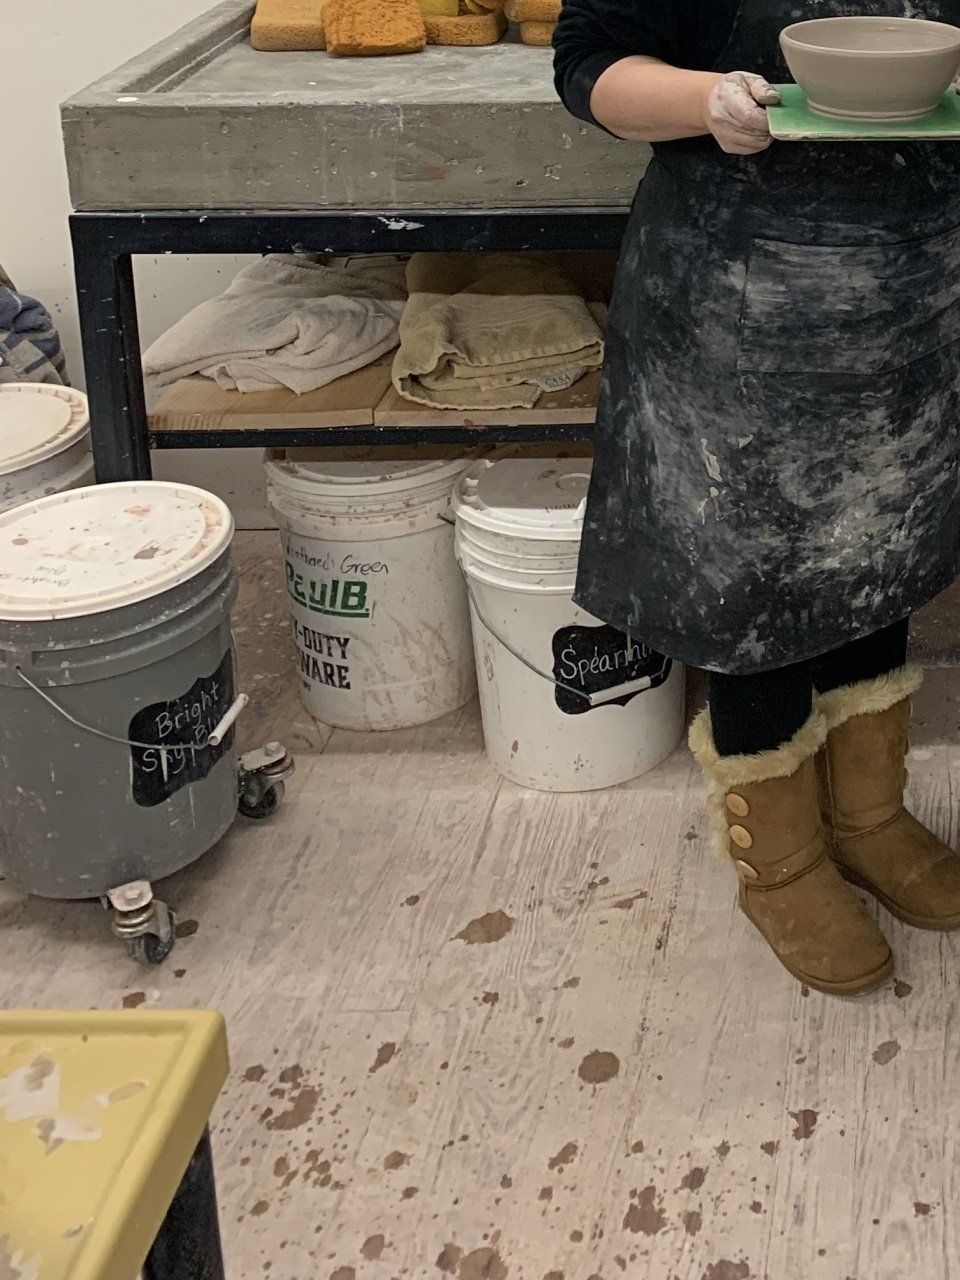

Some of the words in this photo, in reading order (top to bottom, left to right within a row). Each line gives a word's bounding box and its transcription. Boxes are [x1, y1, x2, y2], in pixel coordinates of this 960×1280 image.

[340, 554, 389, 575] Green
[561, 642, 653, 686] Spearmi
[155, 681, 219, 738] Bright
